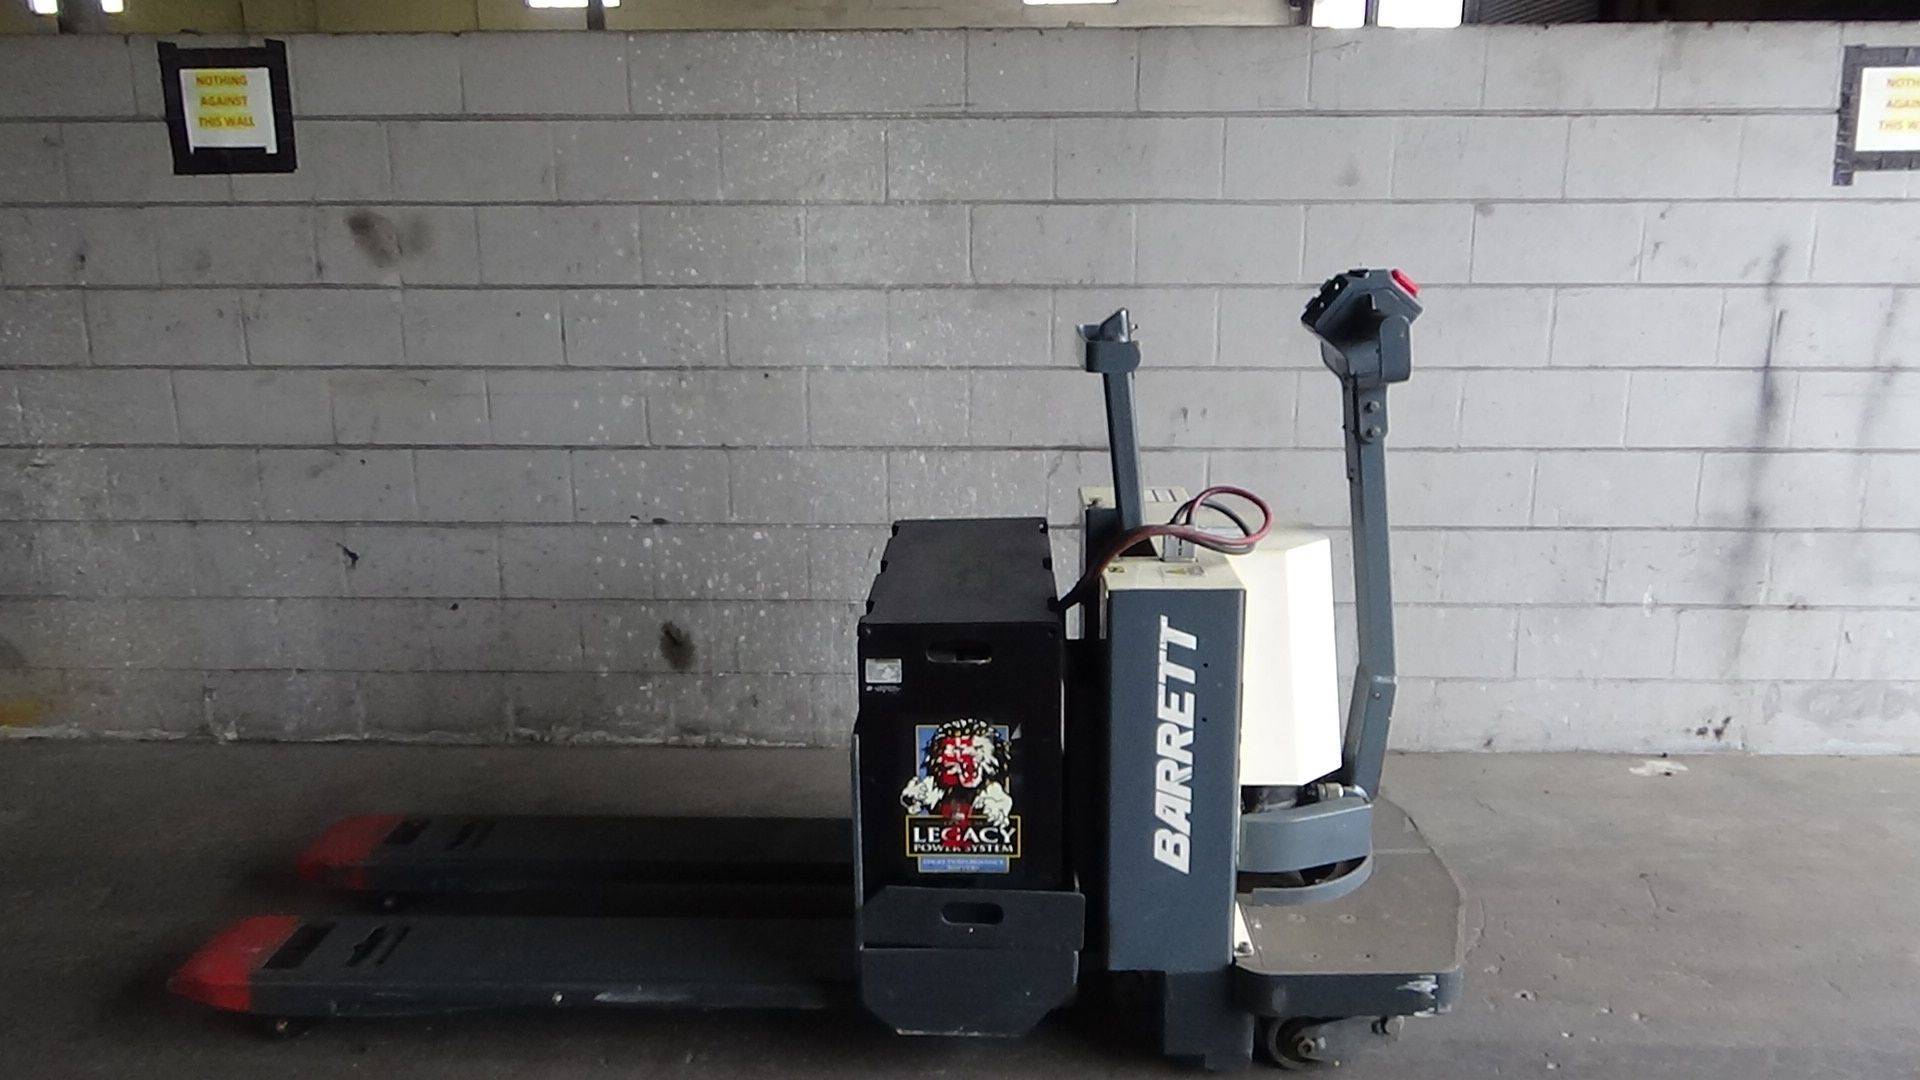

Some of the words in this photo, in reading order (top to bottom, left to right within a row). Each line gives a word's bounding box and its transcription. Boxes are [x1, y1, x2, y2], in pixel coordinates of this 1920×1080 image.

[196, 75, 248, 87] NOTHING
[201, 95, 248, 107] AGAINST
[199, 116, 222, 128] THIS
[223, 115, 256, 128] WALL
[1878, 120, 1903, 130] THIS
[1154, 614, 1198, 875] BARRETT
[913, 826, 1016, 844] LEGACY
